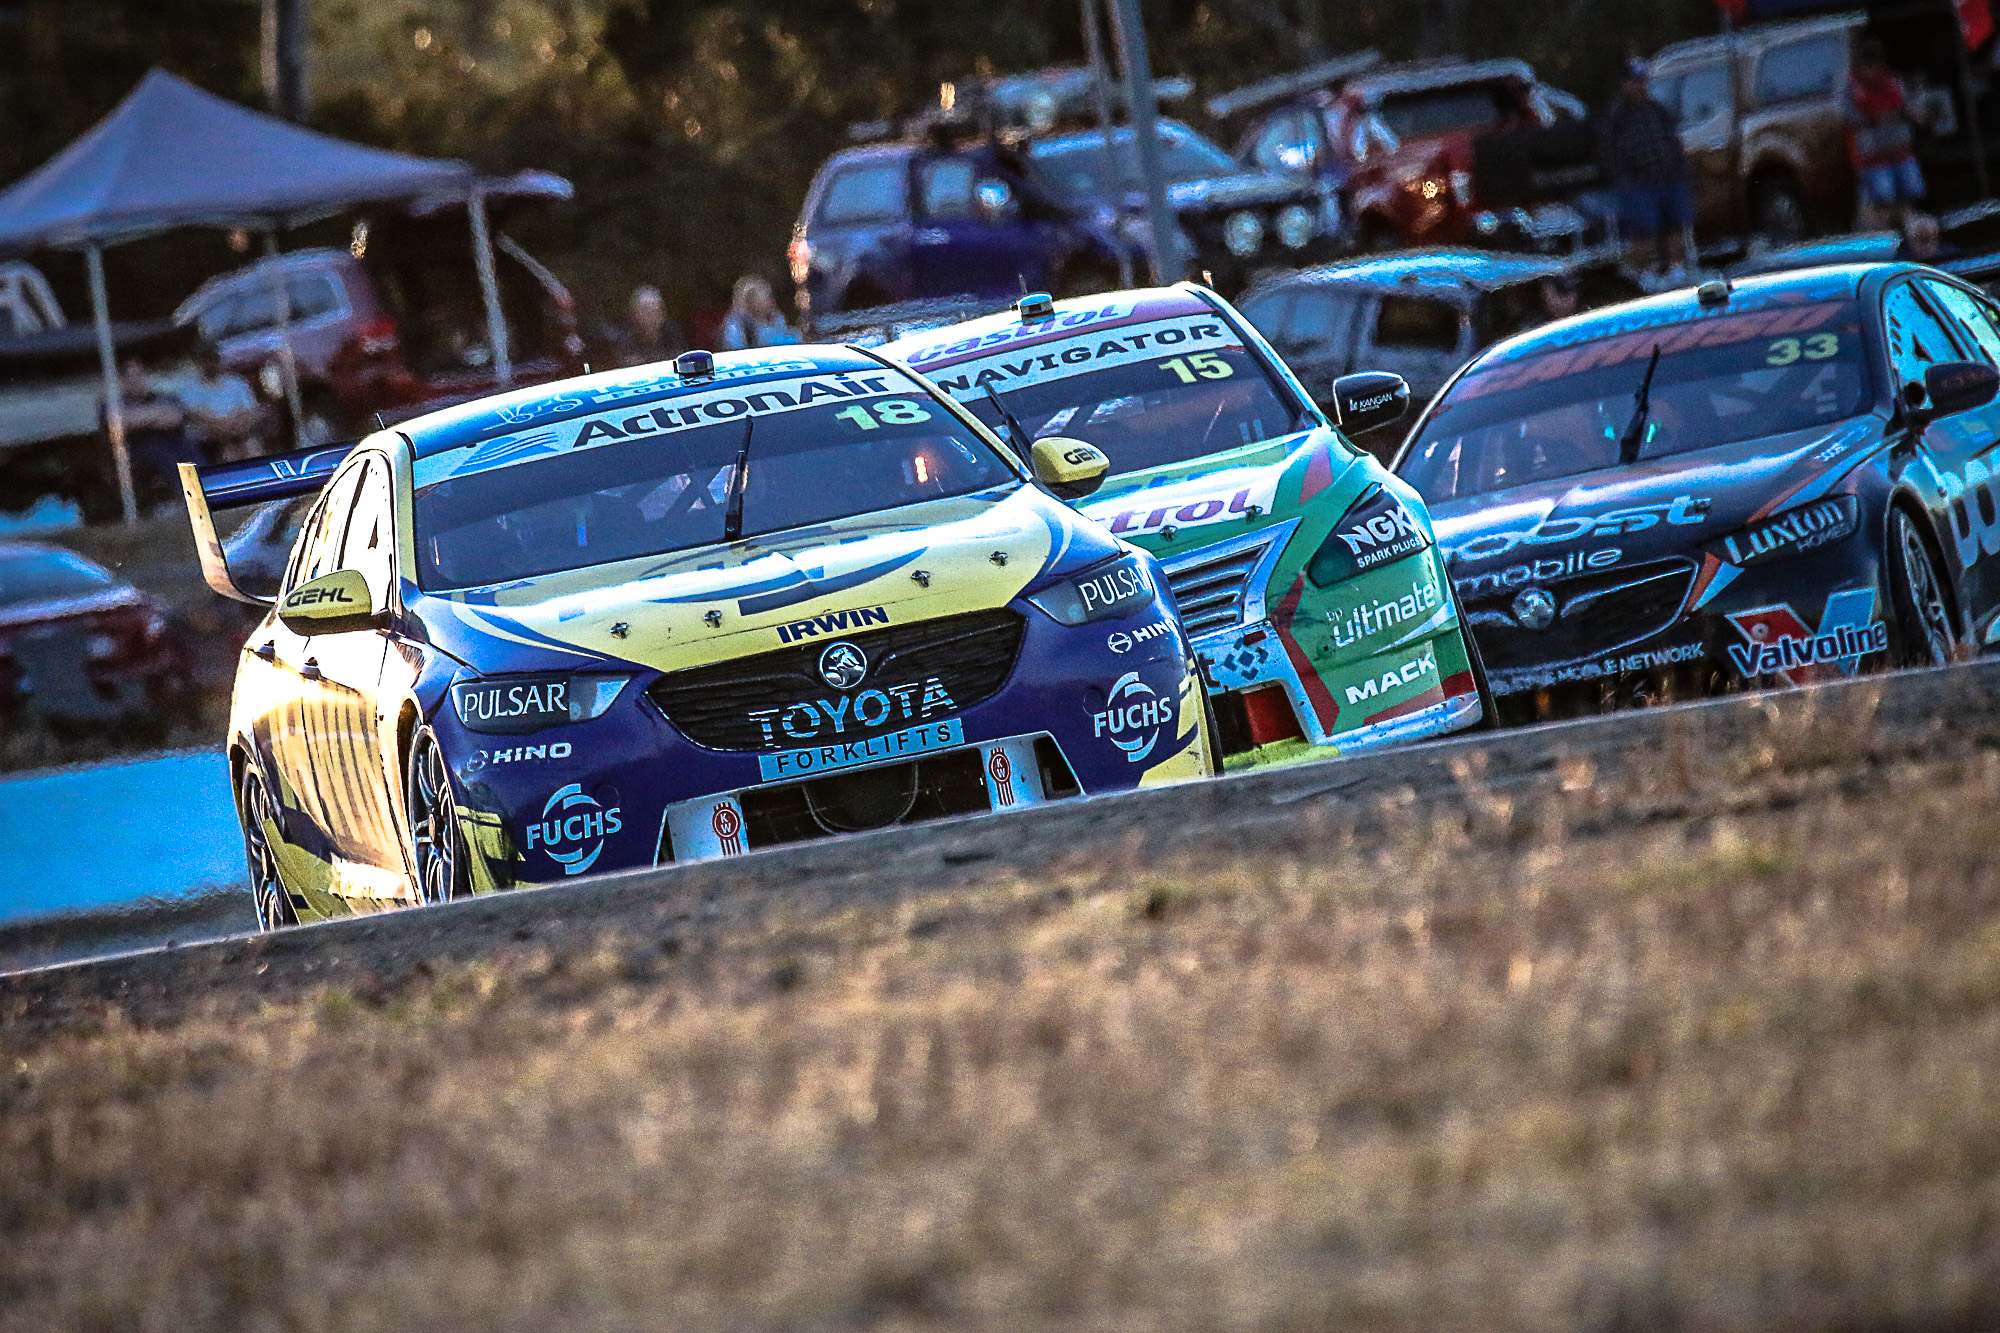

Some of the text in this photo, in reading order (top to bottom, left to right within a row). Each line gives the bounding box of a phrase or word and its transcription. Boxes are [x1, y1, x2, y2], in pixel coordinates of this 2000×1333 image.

[938, 324, 1222, 395] NAVIGATOR
[1159, 351, 1234, 384] 15
[1766, 333, 1838, 366] 33
[572, 373, 889, 448] ActronAir
[836, 399, 932, 431] 18
[1360, 391, 1393, 408] KANGAN
[1098, 488, 1258, 533] trol
[1336, 505, 1416, 555] NGK
[1356, 536, 1421, 569] SPARK PLUGS
[1724, 502, 1843, 565] Luxton
[1454, 548, 1622, 592] mobile
[286, 587, 353, 608] GEHL
[776, 606, 889, 644] IRWIN
[1619, 641, 1705, 672] NETWORK
[1728, 620, 1888, 678] Valvoline
[1345, 652, 1436, 705] MACK
[463, 683, 568, 723] PULSAR
[748, 677, 958, 748] TOYOTA
[1094, 696, 1173, 738] FUCHS
[493, 742, 573, 764] HINO
[776, 723, 951, 773] FORKLIFTS
[526, 807, 622, 850] FUCHS
